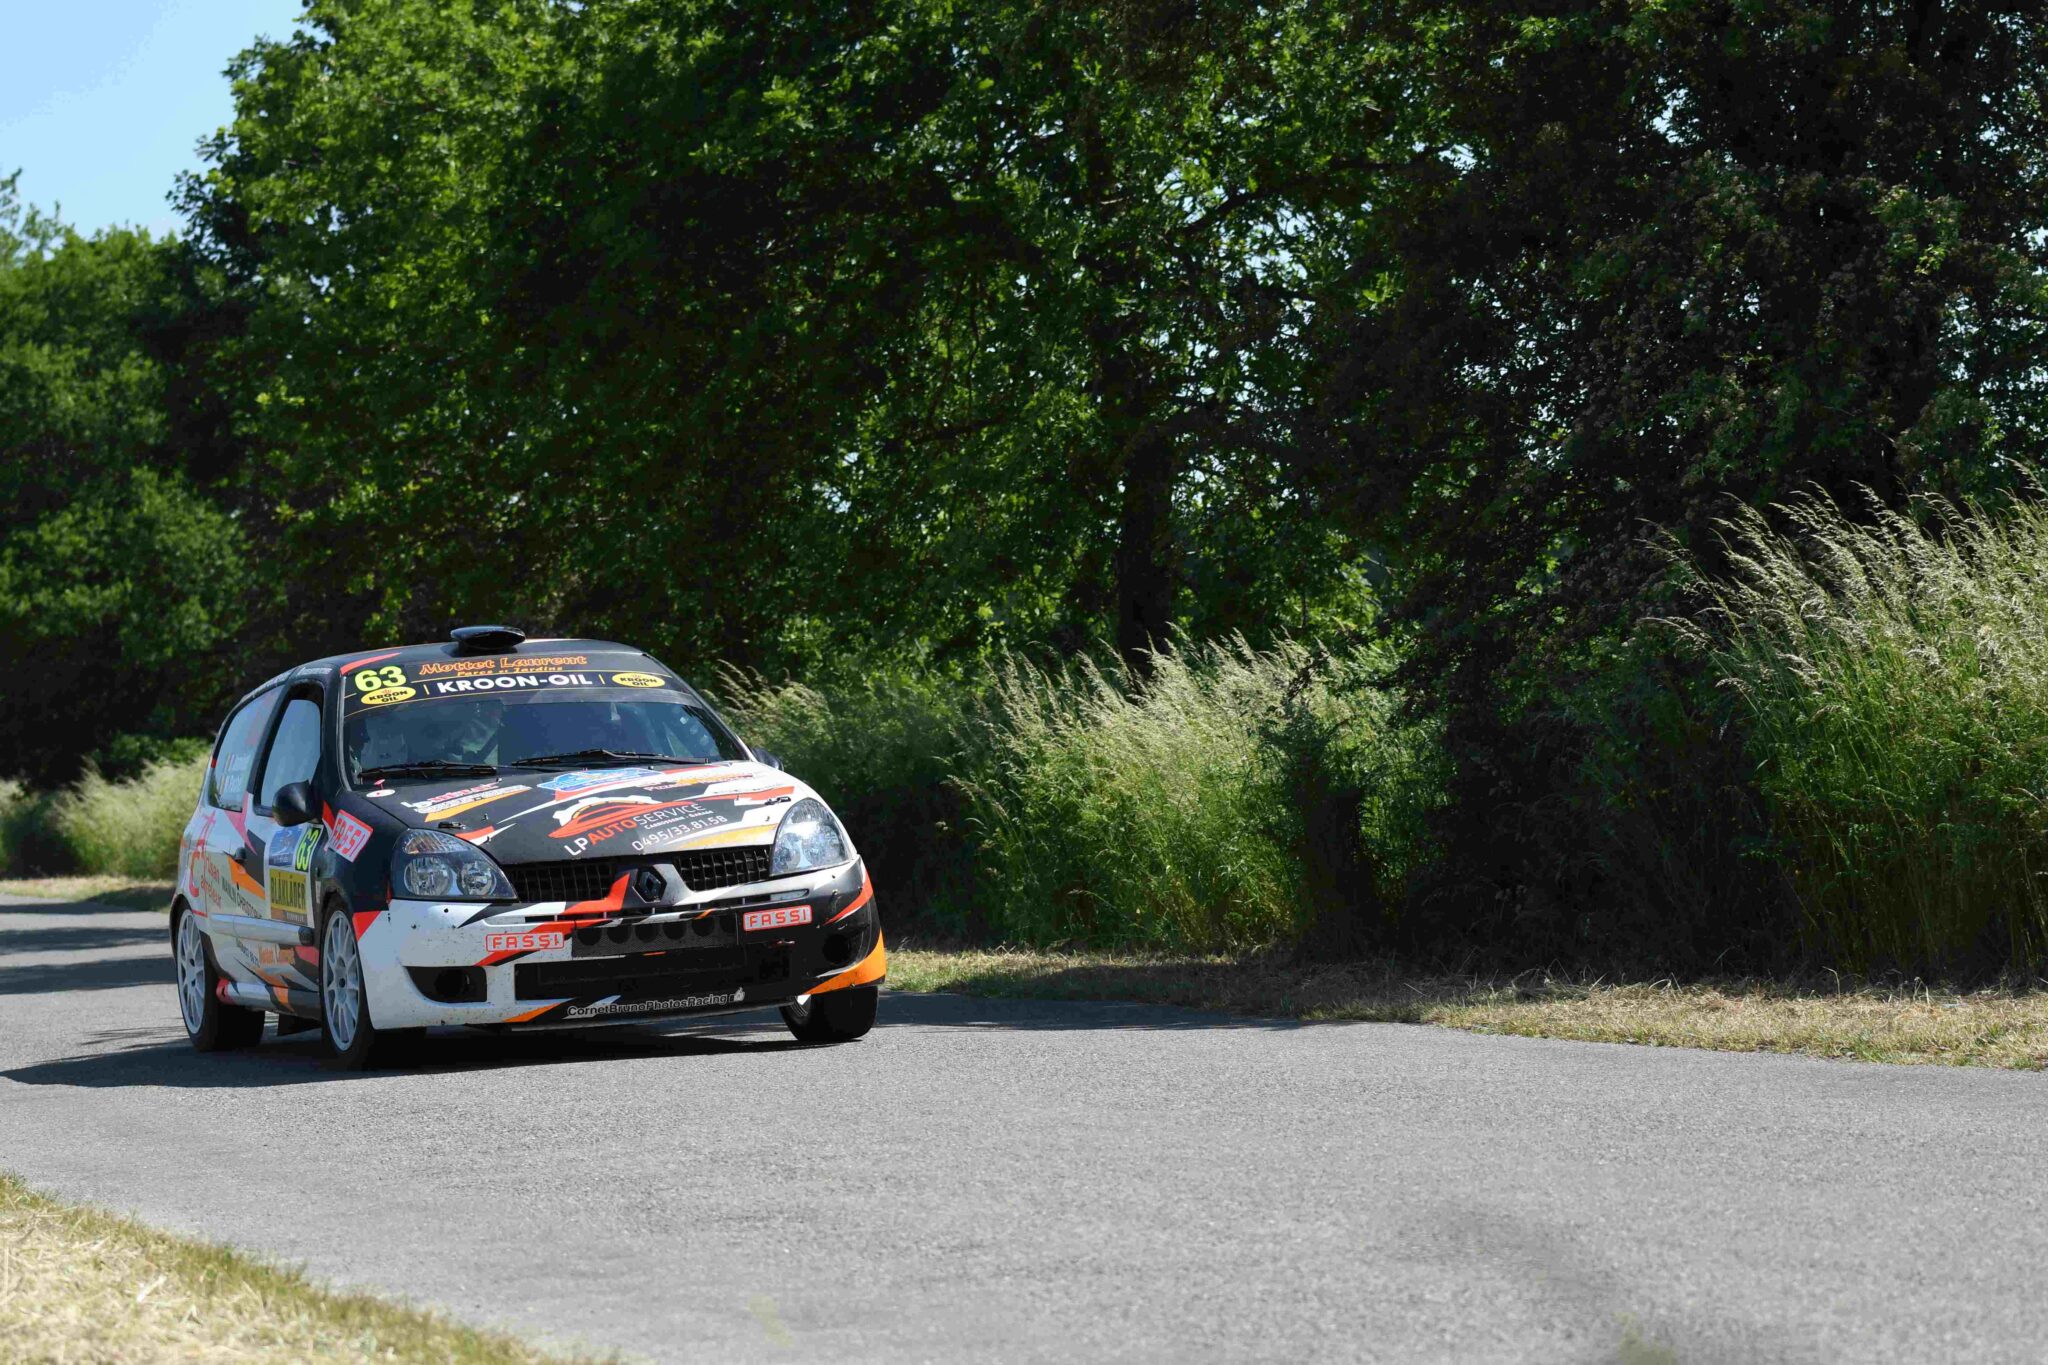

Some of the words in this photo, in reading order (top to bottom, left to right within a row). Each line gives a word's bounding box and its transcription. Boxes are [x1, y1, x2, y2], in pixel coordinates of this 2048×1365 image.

[419, 660, 495, 675] Mottet
[500, 655, 588, 668] Laurent
[354, 665, 407, 692] 63
[437, 674, 593, 694] KROON-OIL
[368, 690, 408, 701] KROON
[330, 815, 367, 858] FASSI
[631, 815, 728, 851] 0495/33.81.58
[296, 828, 319, 872] 63
[749, 907, 808, 927] FASSI
[492, 933, 560, 949] FASSI
[567, 994, 728, 1016] CornetBrunoPhotosRacing
